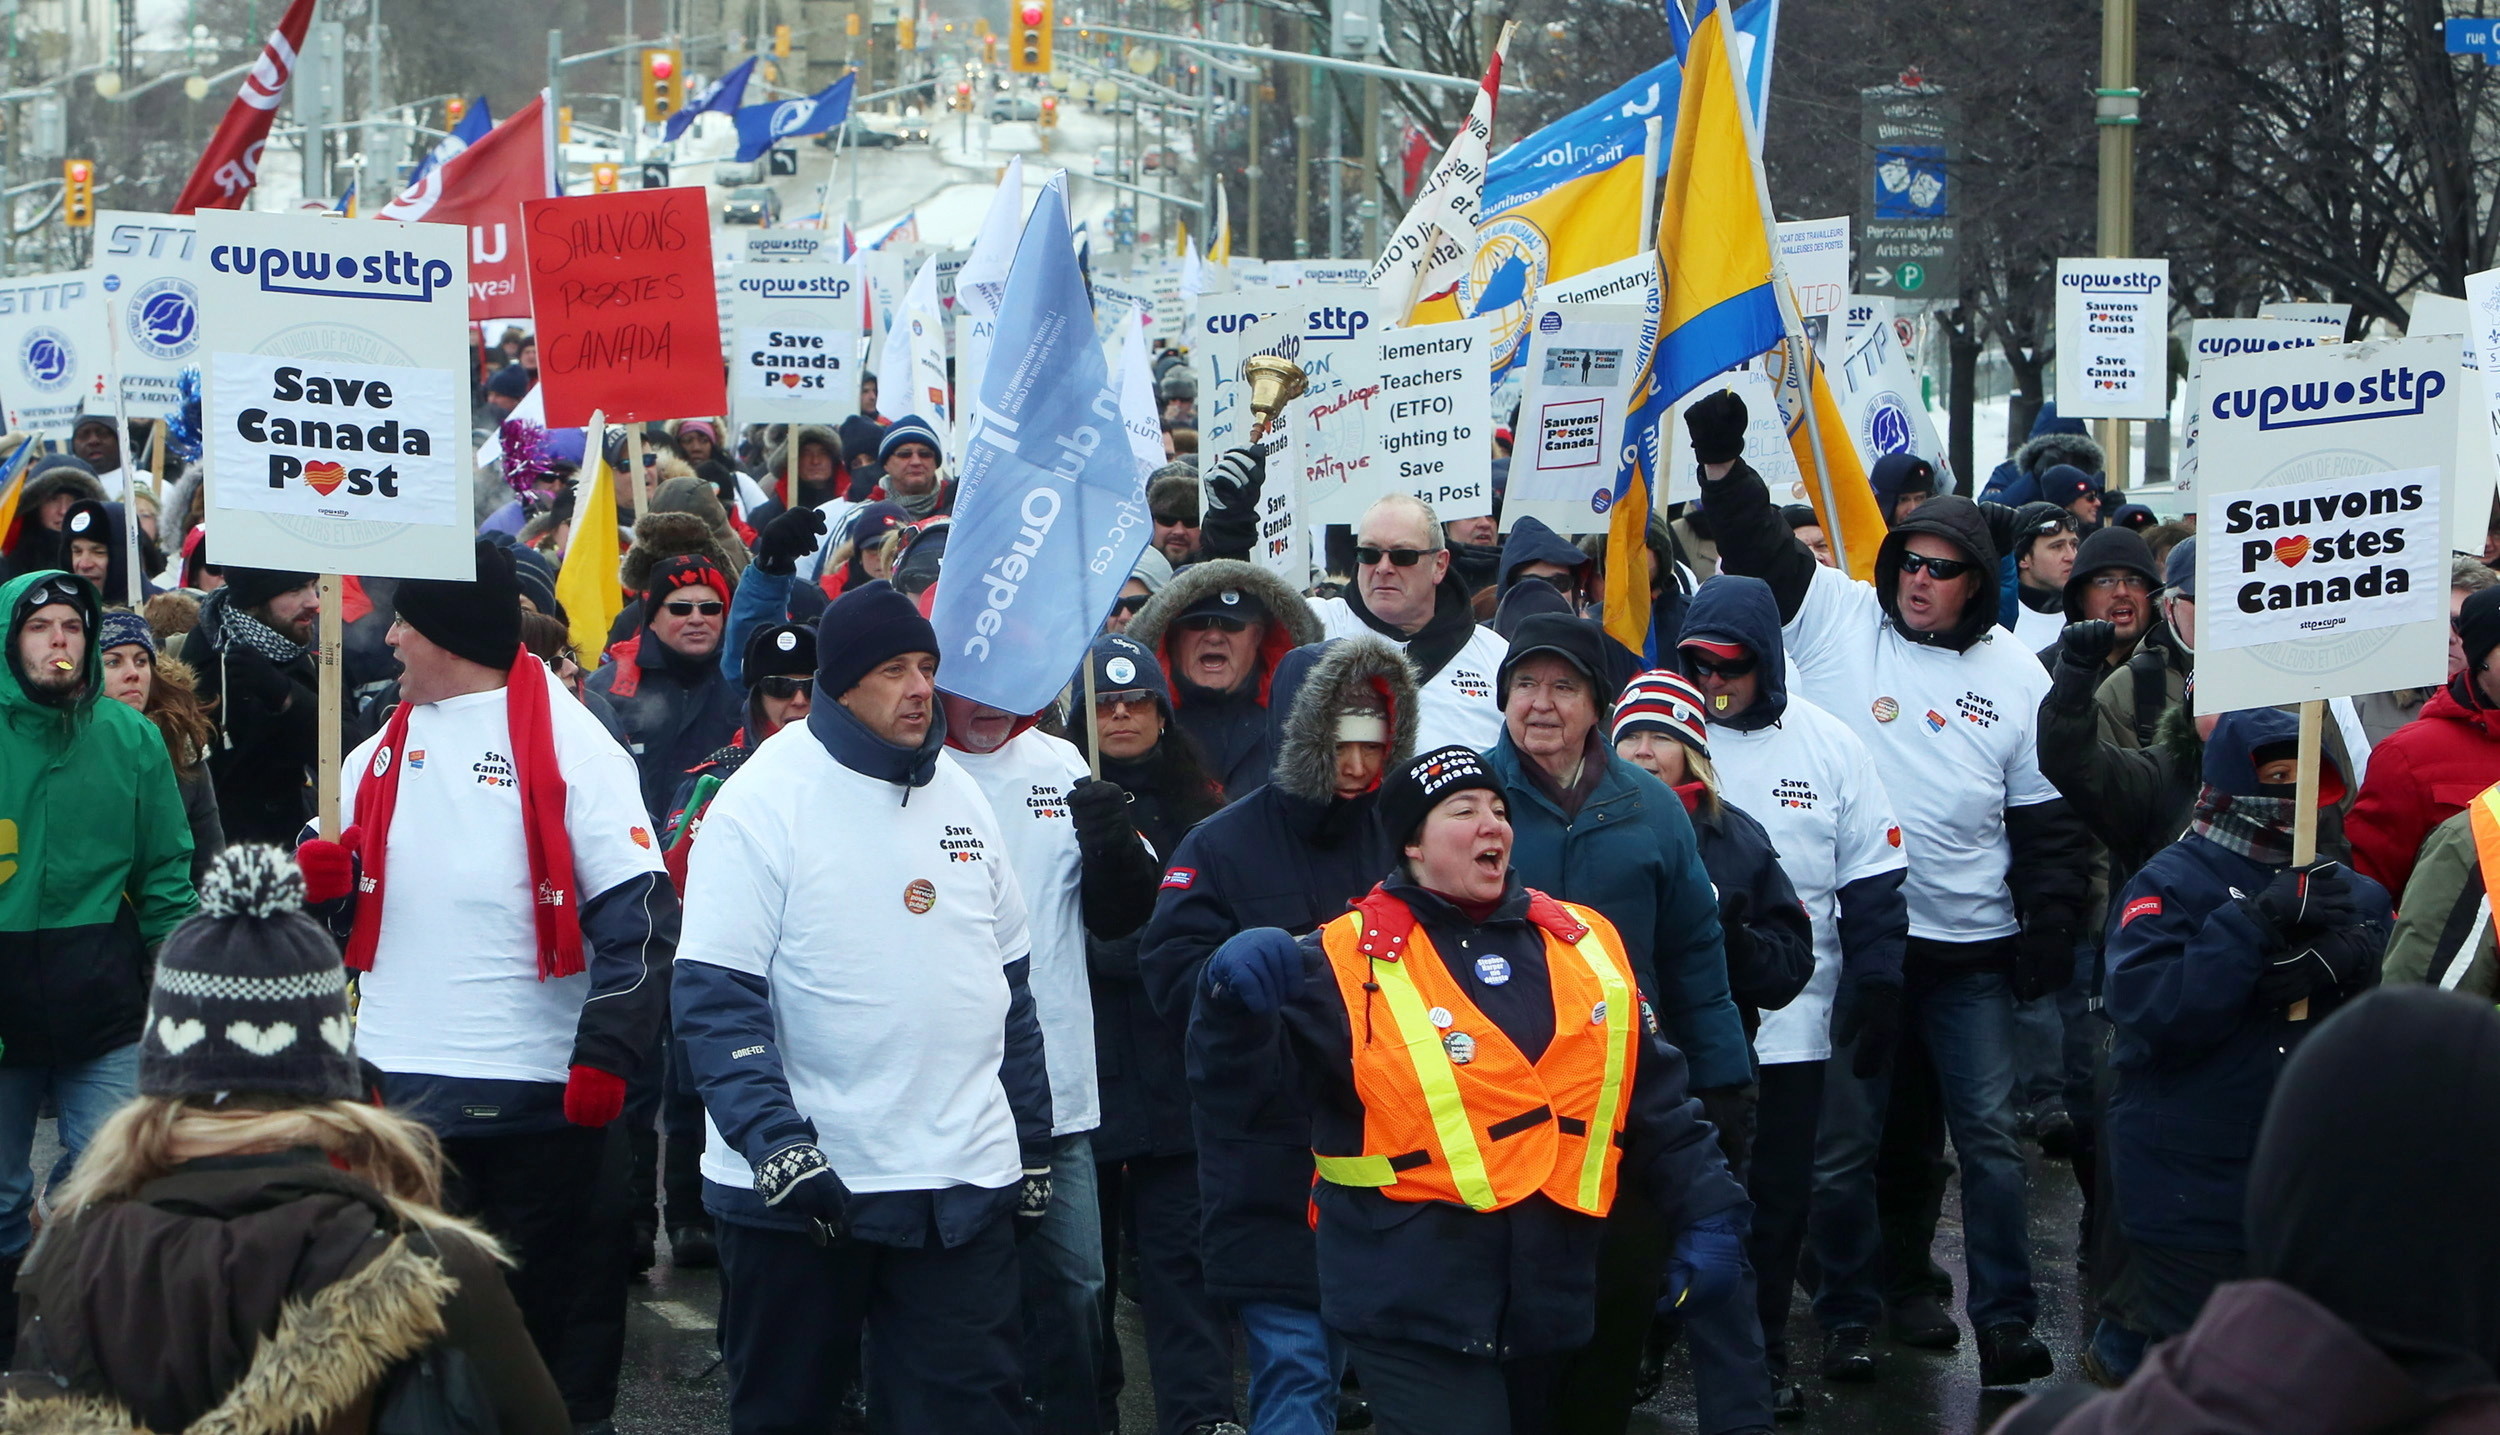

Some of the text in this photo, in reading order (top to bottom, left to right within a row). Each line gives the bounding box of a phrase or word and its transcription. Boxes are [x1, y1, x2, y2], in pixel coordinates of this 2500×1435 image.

[2466, 33, 2486, 45] rue
[534, 197, 686, 275] SAUVONS
[1794, 228, 1844, 242] DES TRAVAILLEURS
[1929, 225, 1954, 239] Arts
[107, 224, 196, 260] STT
[1813, 242, 1825, 252] DES
[1824, 240, 1844, 251] POSTES
[1875, 244, 1901, 257] Arts
[2085, 301, 2139, 312] Sauvons
[2088, 324, 2135, 334] Canada
[549, 321, 672, 375] CANADA
[768, 332, 824, 349] Save
[1379, 336, 1473, 361] lementary
[751, 351, 841, 370] Canada
[1843, 321, 1889, 394] TTP
[2095, 355, 2126, 366] Save
[1380, 366, 1463, 390] Teachers
[2086, 367, 2136, 378] Canada
[273, 366, 393, 409] Save
[1390, 396, 1454, 423] (ETFO)
[1544, 414, 1600, 429] Sauvons
[237, 408, 431, 456] Canada
[1380, 425, 1471, 453] ighting to
[1545, 438, 1595, 452] Canada
[1399, 459, 1444, 478] Save
[1439, 482, 1481, 502] Post
[1267, 493, 1287, 515] Save
[2225, 484, 2424, 535] Sauvons
[1263, 510, 1292, 539] Canada
[2237, 564, 2410, 615] Canada
[1456, 669, 1481, 678] Save
[1965, 690, 1994, 708] Save
[1955, 698, 2000, 722] Canada
[472, 762, 513, 777] Cana
[1424, 765, 1483, 796] Canada
[1780, 778, 1810, 789] Save
[1032, 785, 1058, 795] Save
[1772, 788, 1818, 800] Canada
[945, 825, 973, 837] Save
[939, 838, 985, 850] Canada
[731, 1045, 765, 1060] GORE-TEX
